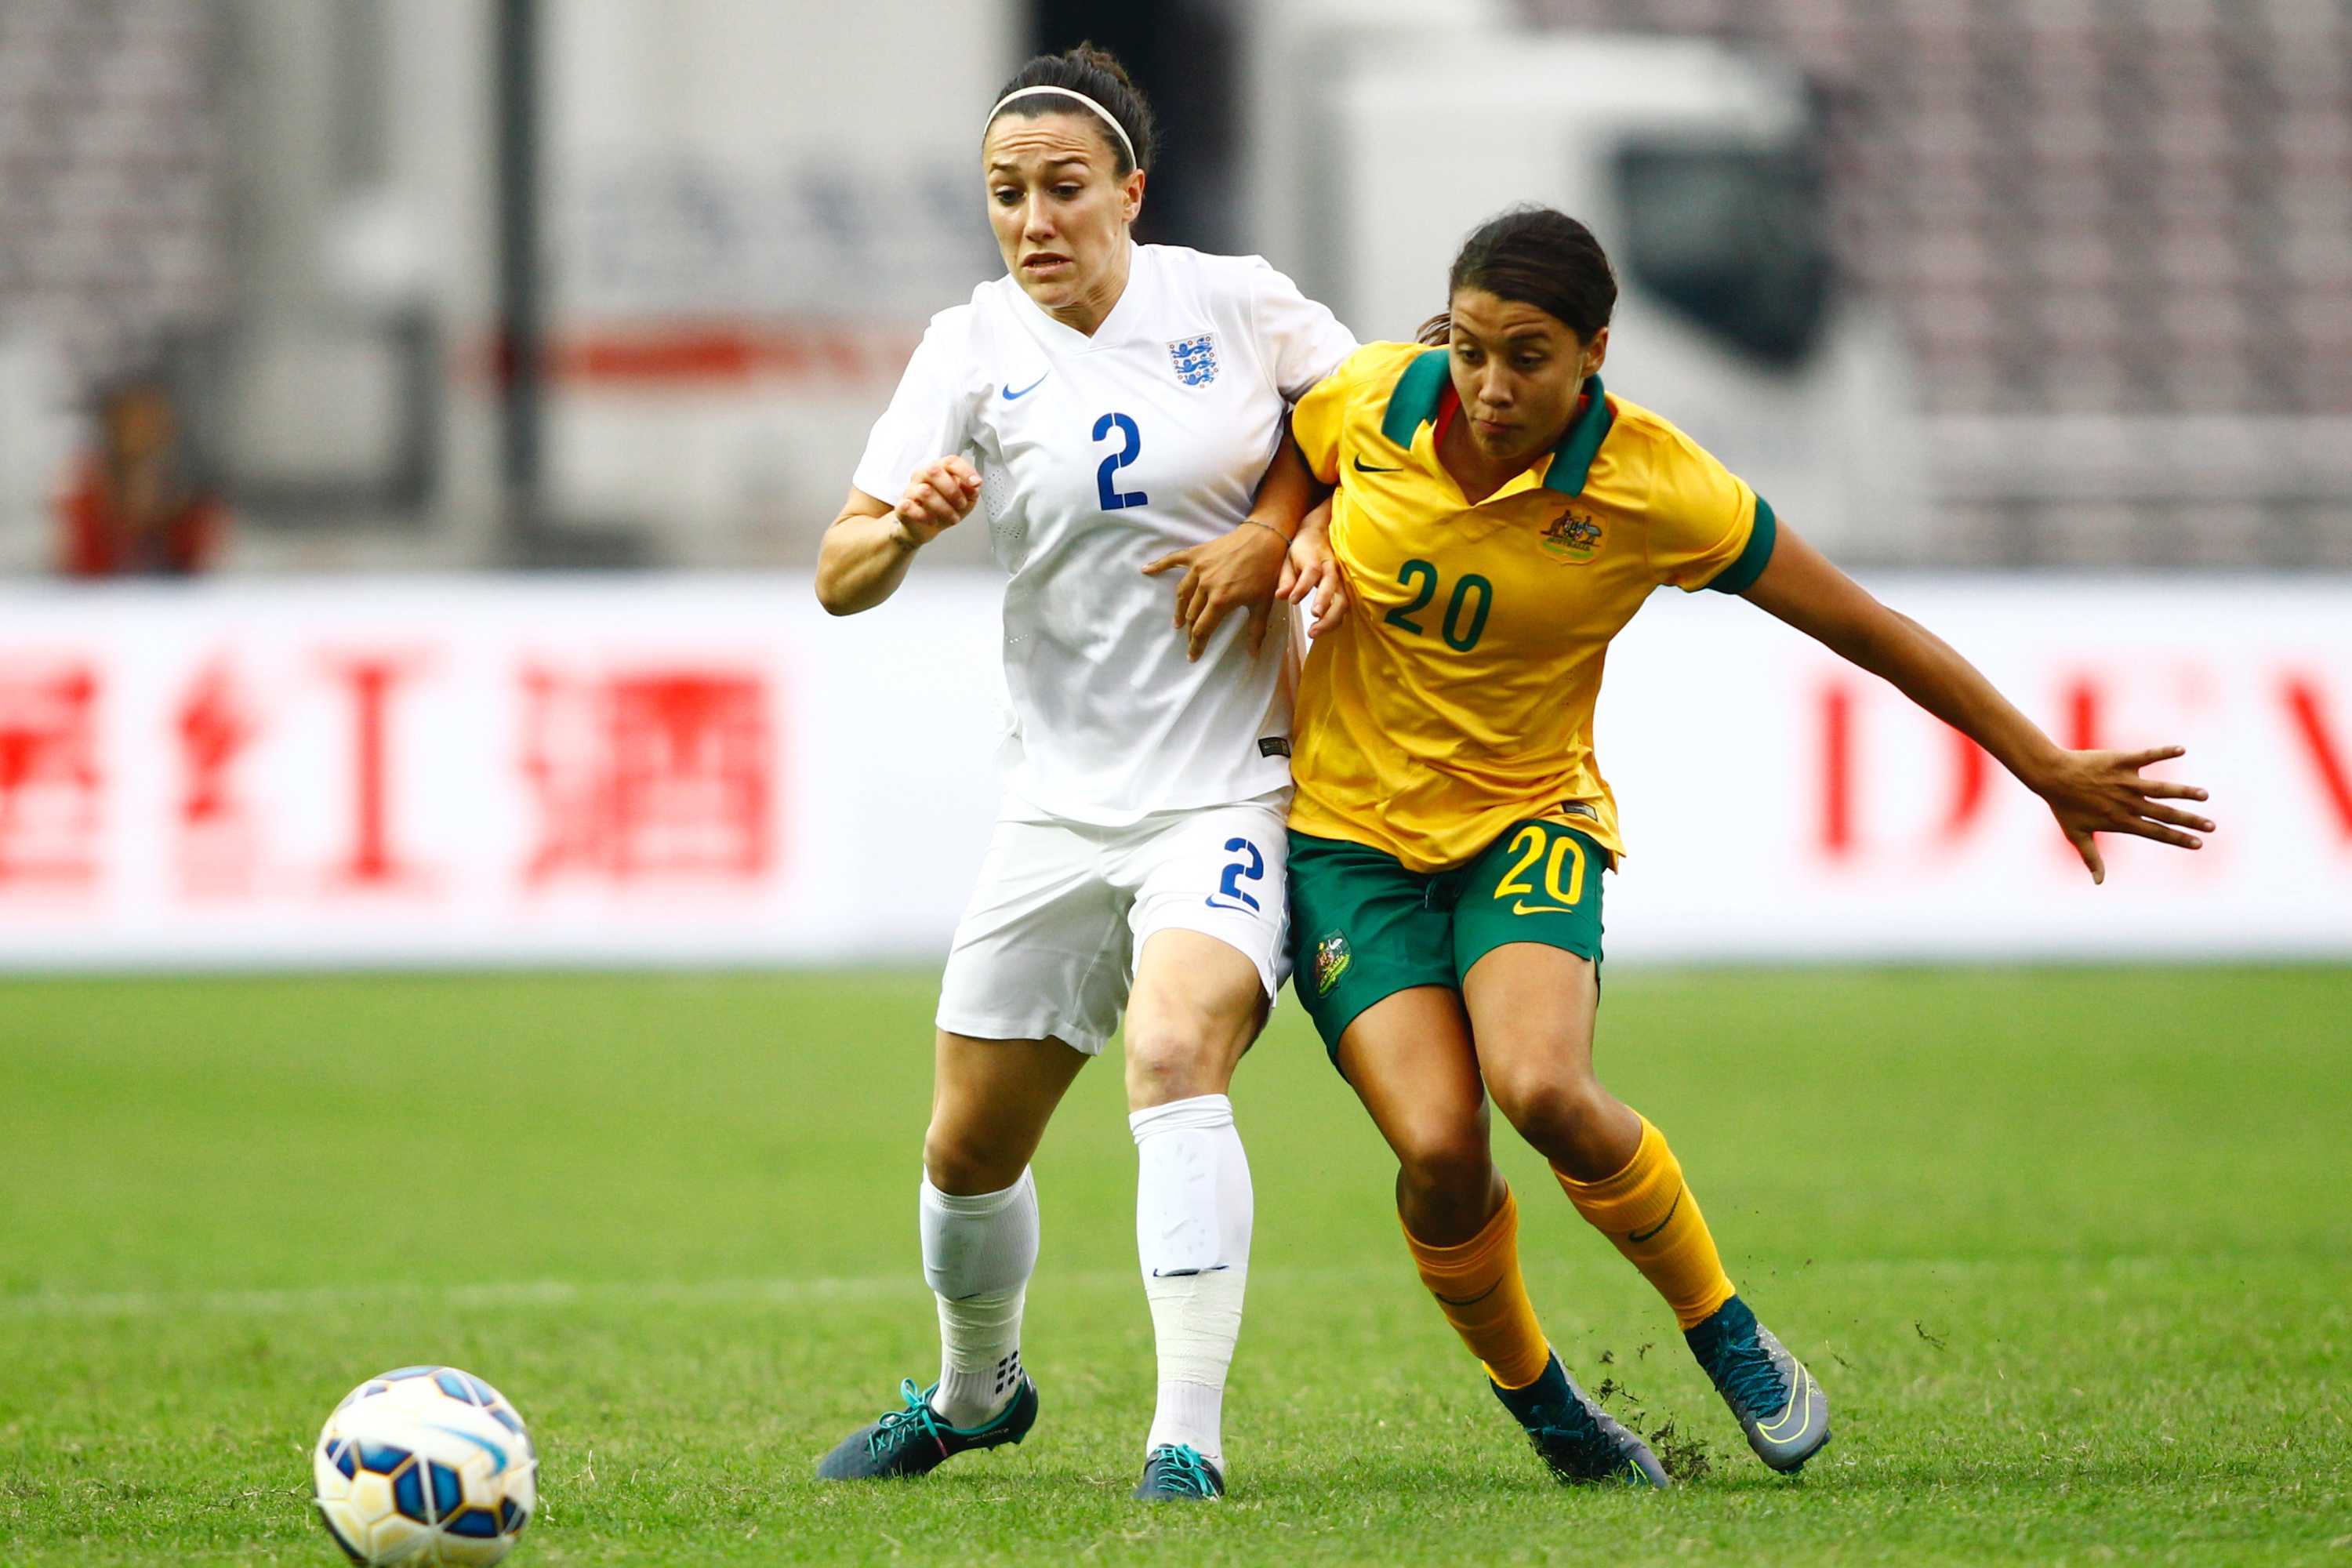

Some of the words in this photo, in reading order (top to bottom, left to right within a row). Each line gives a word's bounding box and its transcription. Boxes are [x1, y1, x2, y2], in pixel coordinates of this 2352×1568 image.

[1092, 412, 1148, 510] 2
[1385, 559, 1493, 652] 20
[1219, 837, 1264, 912] 2
[1494, 826, 1584, 905] 20
